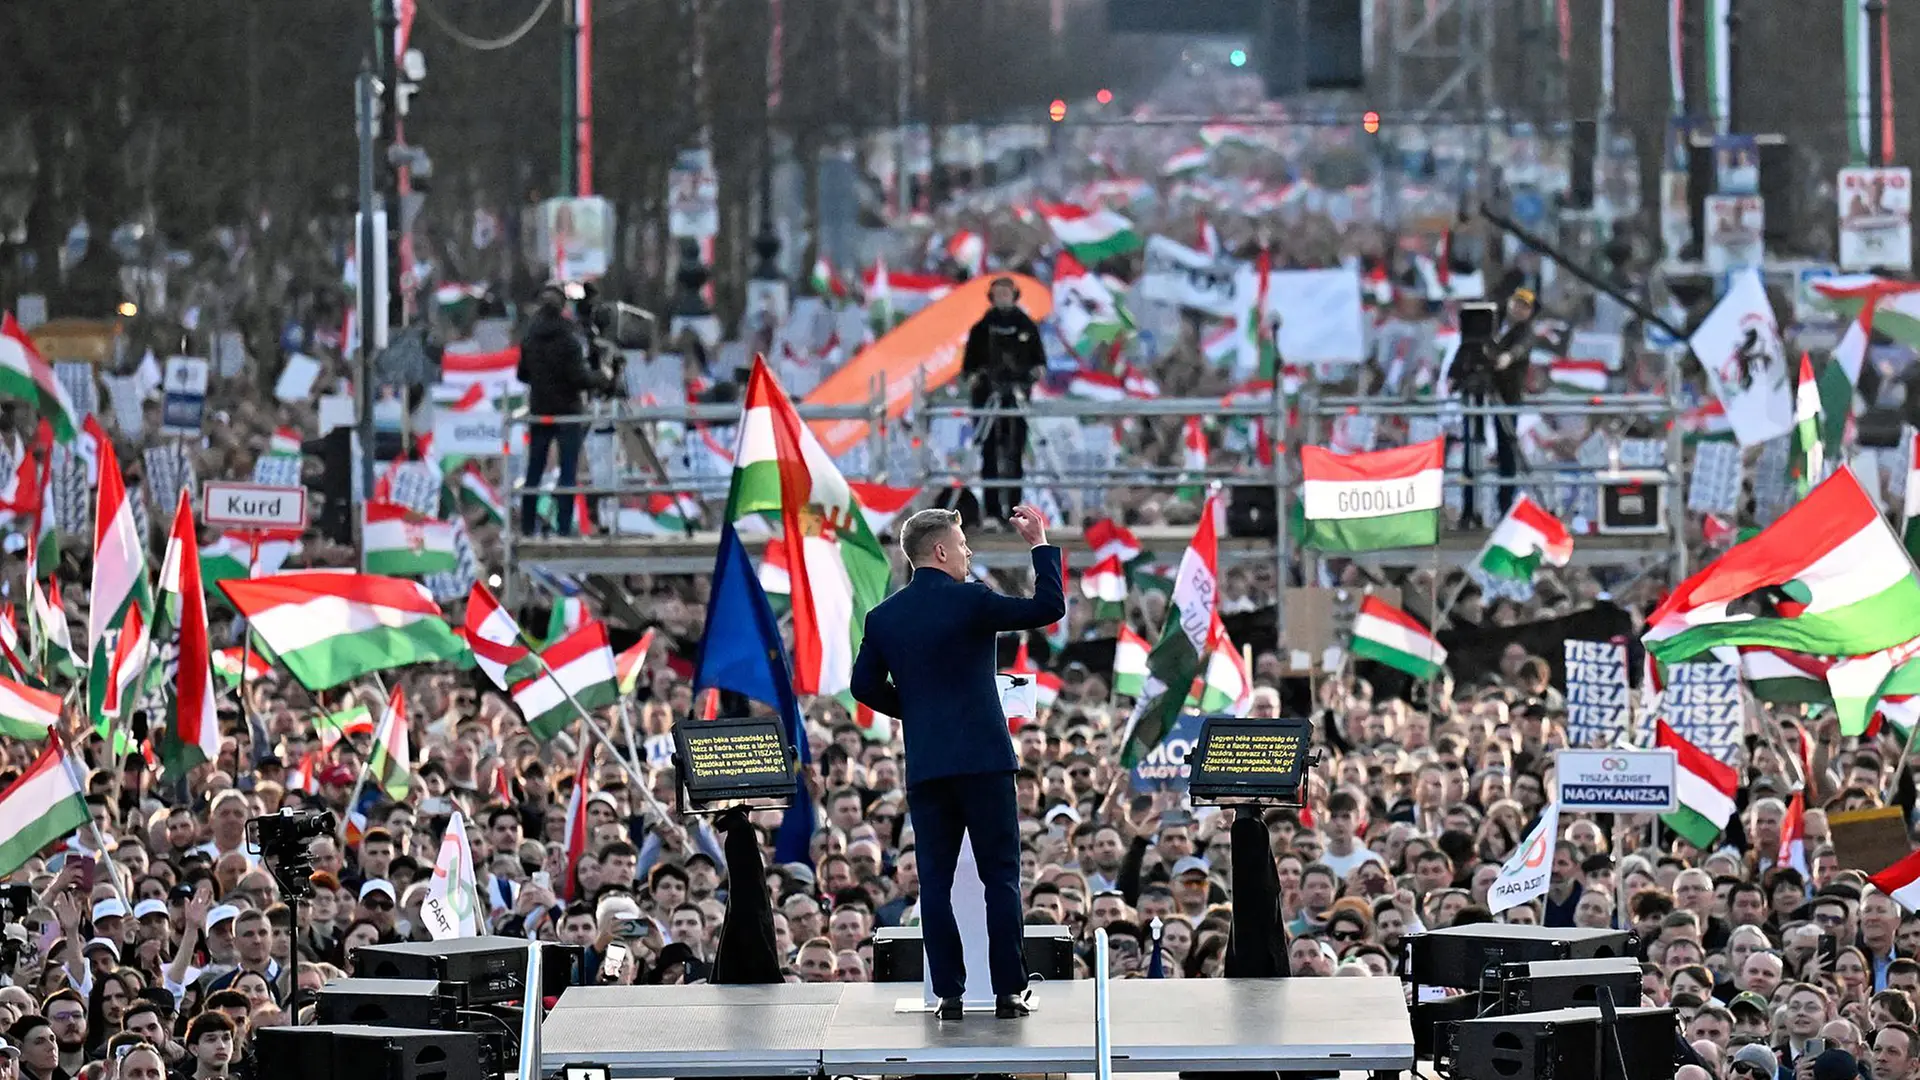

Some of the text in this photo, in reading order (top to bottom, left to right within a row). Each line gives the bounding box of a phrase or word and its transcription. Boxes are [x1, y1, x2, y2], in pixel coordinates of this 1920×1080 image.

[228, 496, 281, 517] Kurd
[1338, 482, 1415, 513] GÖDÖLLŐ
[1564, 639, 1626, 663] TISZA
[1565, 660, 1626, 684] TISZA
[1668, 663, 1738, 683] TISZA
[1566, 681, 1627, 705] TISZA
[1666, 680, 1739, 704] TISZA
[1567, 703, 1628, 727] TISZA
[1668, 701, 1741, 726] TISZA
[689, 736, 712, 745] Legyen
[730, 734, 764, 743] szabadság
[1211, 735, 1234, 743] Legyen
[695, 760, 725, 768] Zászlókat
[721, 751, 747, 759] szavazz
[720, 767, 744, 776] magyar
[1580, 774, 1651, 783] TISZA SZIGET
[1565, 788, 1667, 802] NAGYKANIZSA
[428, 898, 452, 933] PÁRT
